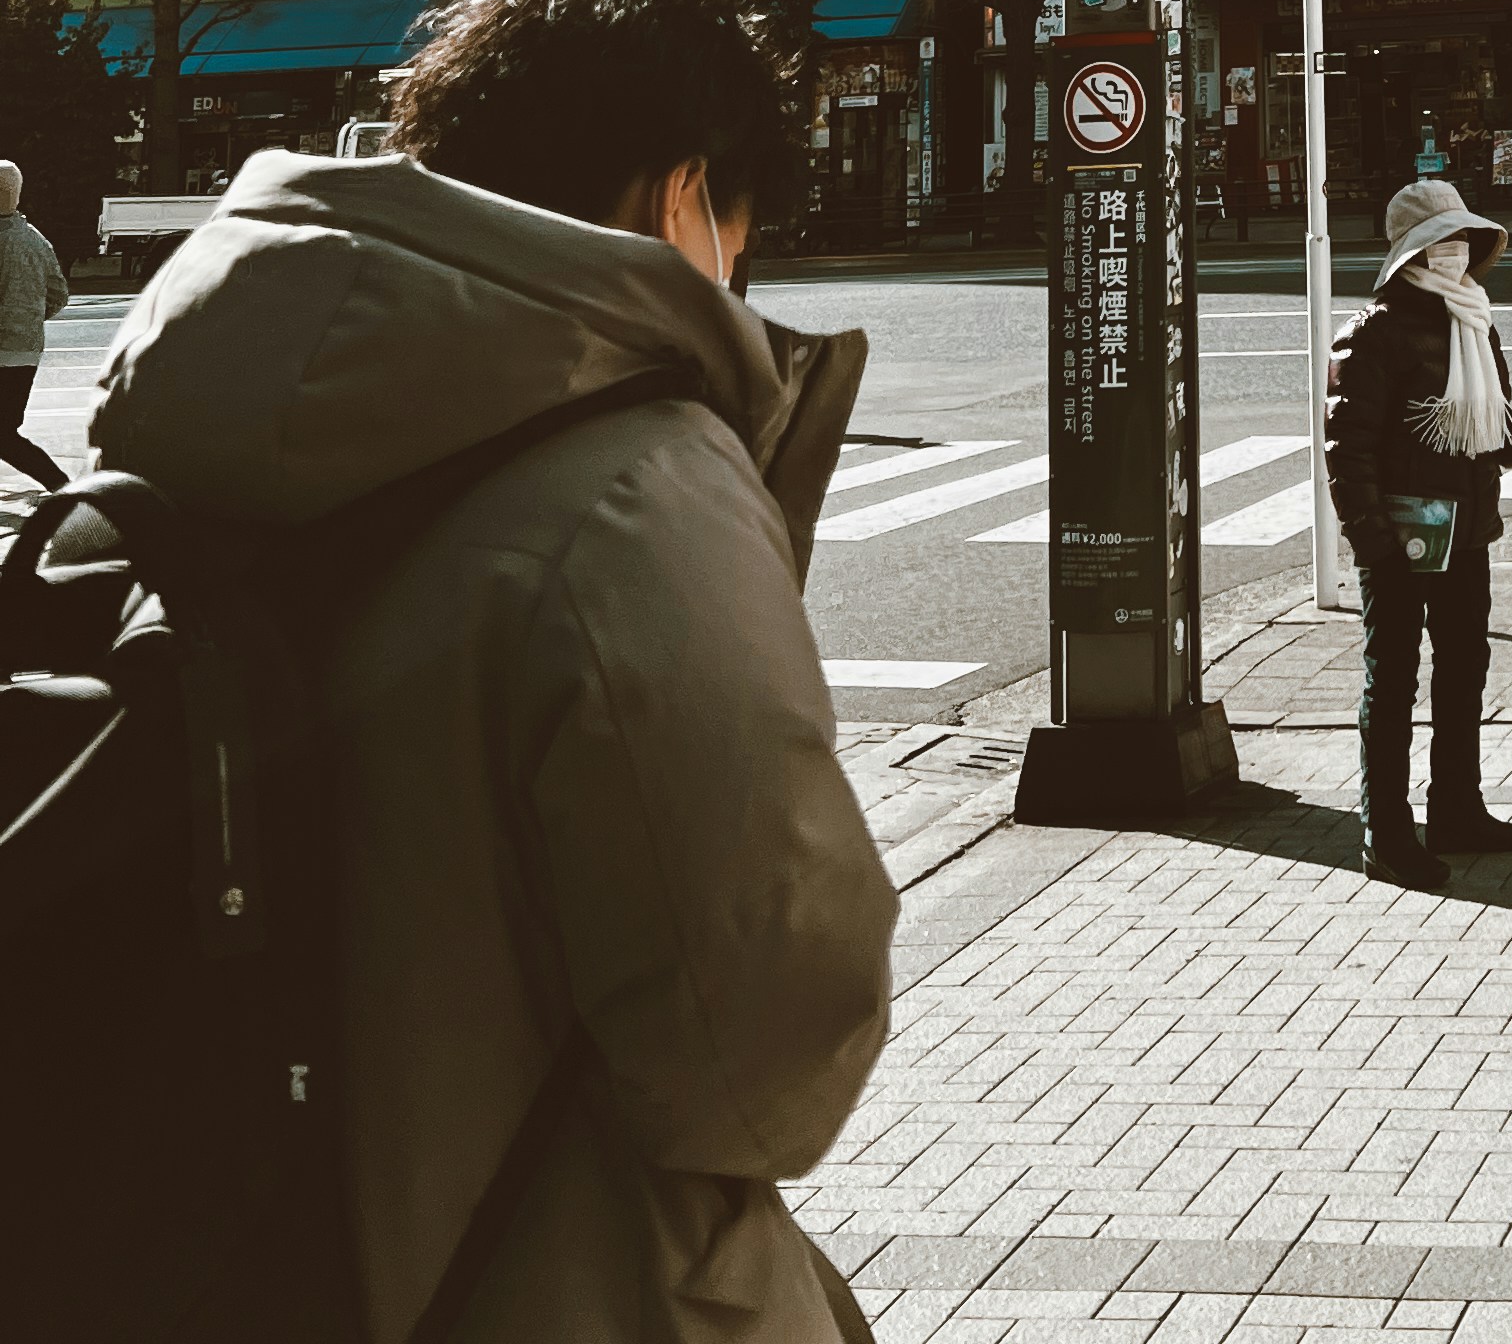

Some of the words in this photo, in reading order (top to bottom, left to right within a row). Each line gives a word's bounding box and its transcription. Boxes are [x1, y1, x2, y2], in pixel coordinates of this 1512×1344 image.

[1082, 192, 1096, 218] No
[1077, 224, 1097, 309] Smoking
[1099, 190, 1128, 388] 路上喫煙禁止
[1082, 315, 1093, 340] on
[1082, 346, 1097, 379] the
[1082, 385, 1095, 443] street
